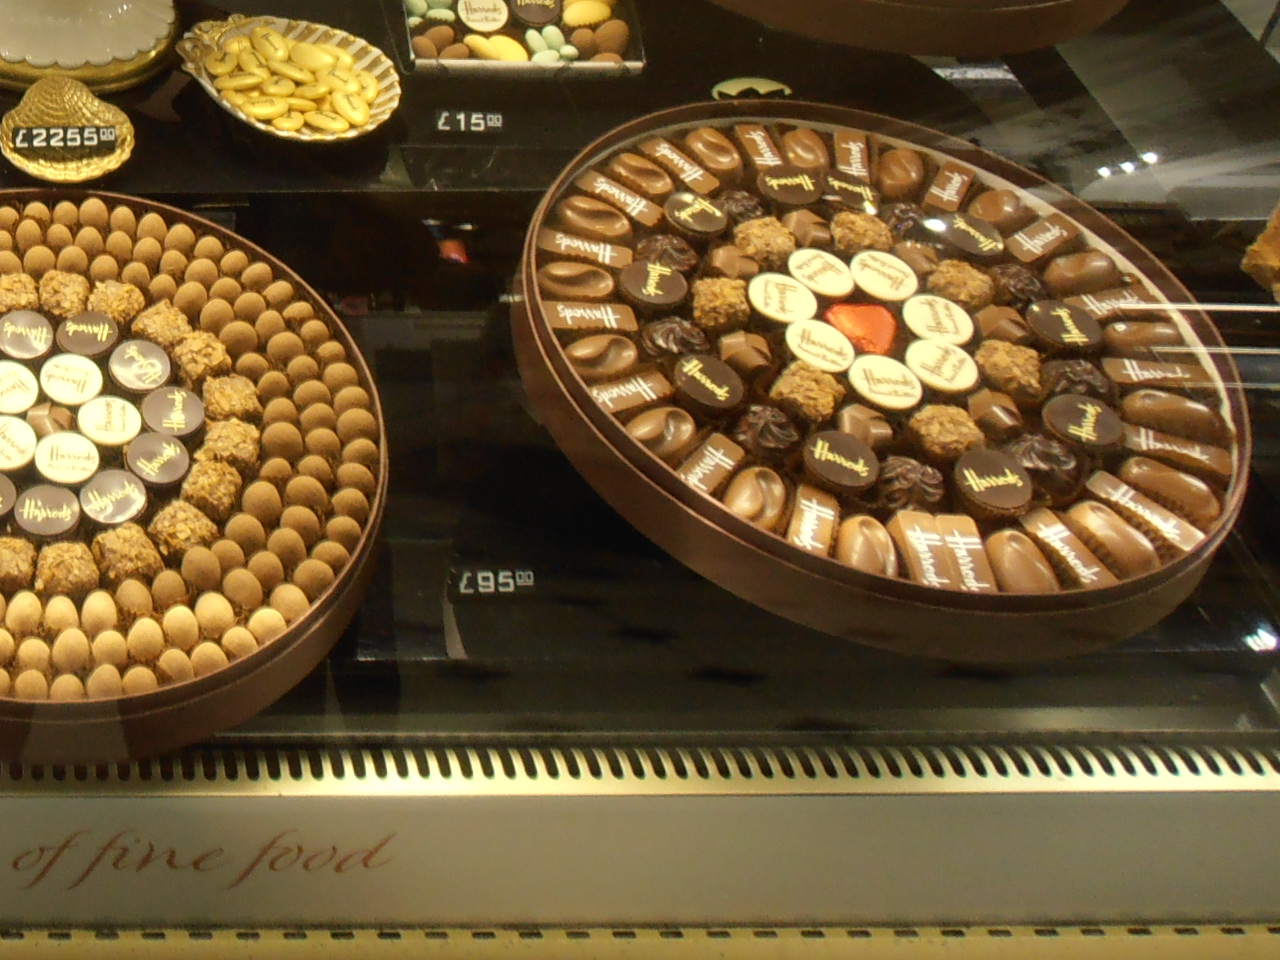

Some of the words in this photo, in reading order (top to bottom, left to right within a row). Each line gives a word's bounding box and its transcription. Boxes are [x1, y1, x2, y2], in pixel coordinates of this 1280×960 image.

[655, 142, 704, 183] Harrods
[593, 177, 648, 217] Harrods
[554, 232, 618, 264] Harrods
[1013, 222, 1068, 254] Harrods
[65, 320, 113, 343] Harrods
[557, 303, 621, 329] Harrods
[592, 376, 658, 405] Harrods
[682, 358, 731, 402] Harrods
[810, 439, 870, 478] Harrods
[962, 468, 1024, 493] Harrods
[18, 497, 73, 523] Harrods
[1036, 522, 1102, 584] Harrods
[11, 827, 93, 891] of
[66, 828, 235, 891] fine
[225, 828, 399, 891] food
